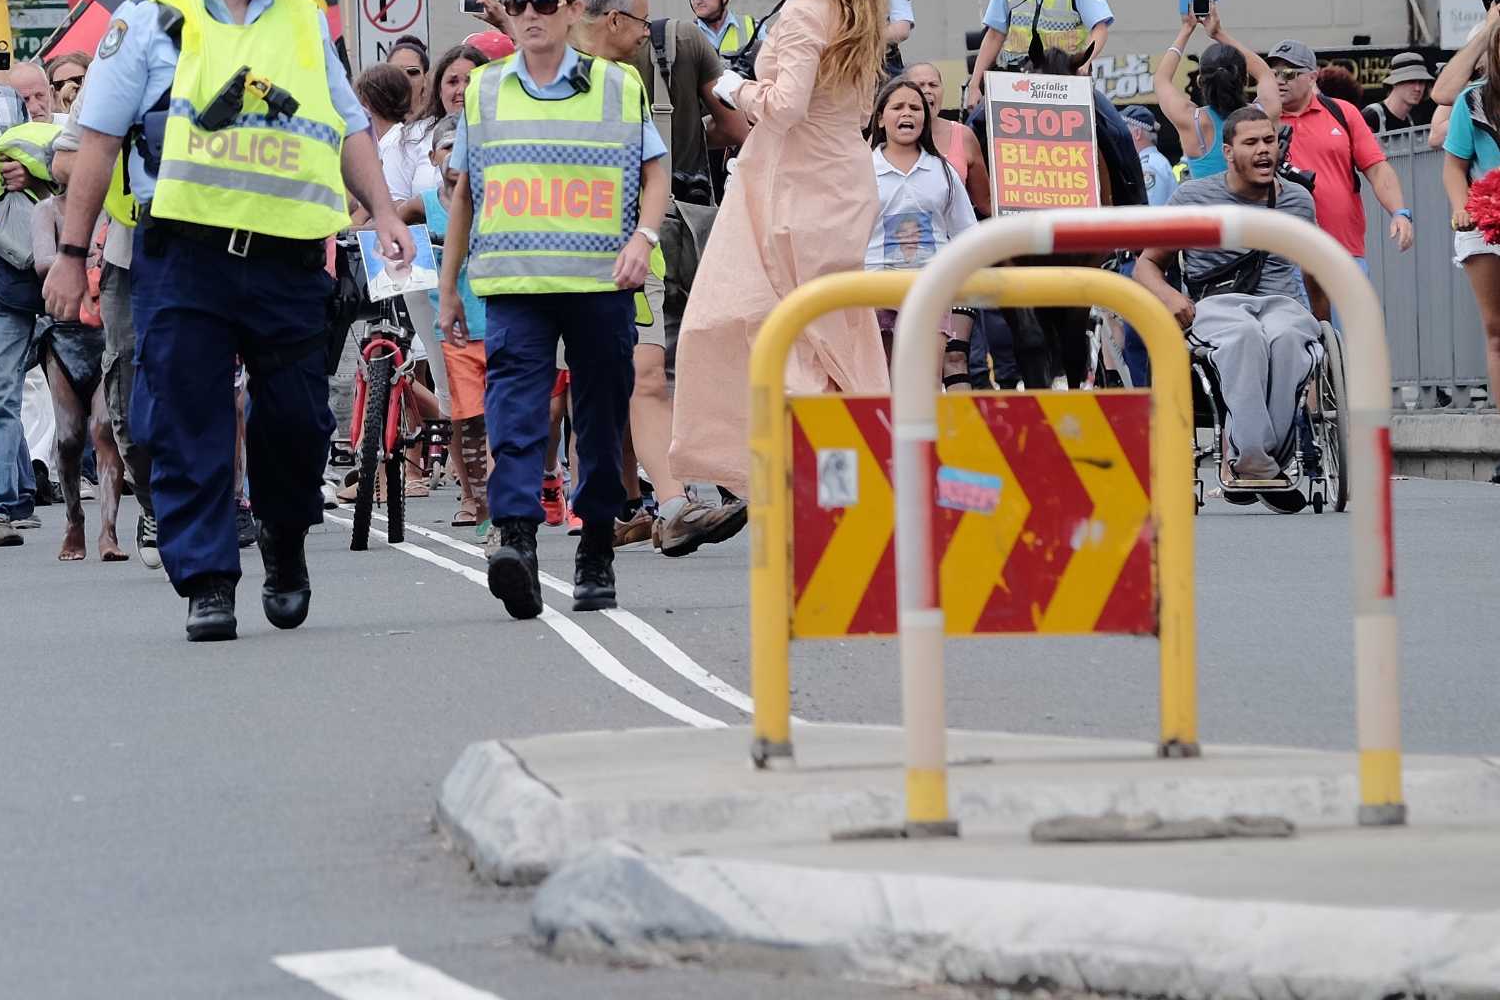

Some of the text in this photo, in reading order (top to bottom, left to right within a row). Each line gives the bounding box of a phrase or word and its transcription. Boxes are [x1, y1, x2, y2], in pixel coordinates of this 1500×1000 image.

[1029, 81, 1069, 92] Socialist
[1030, 90, 1069, 100] Alliance
[999, 107, 1085, 137] STOP
[187, 128, 301, 171] POLICE
[1001, 142, 1088, 168] BLACK
[1003, 168, 1089, 190] DEATHS
[483, 178, 615, 219] POLICE
[1004, 190, 1090, 206] IN CUSTODY
